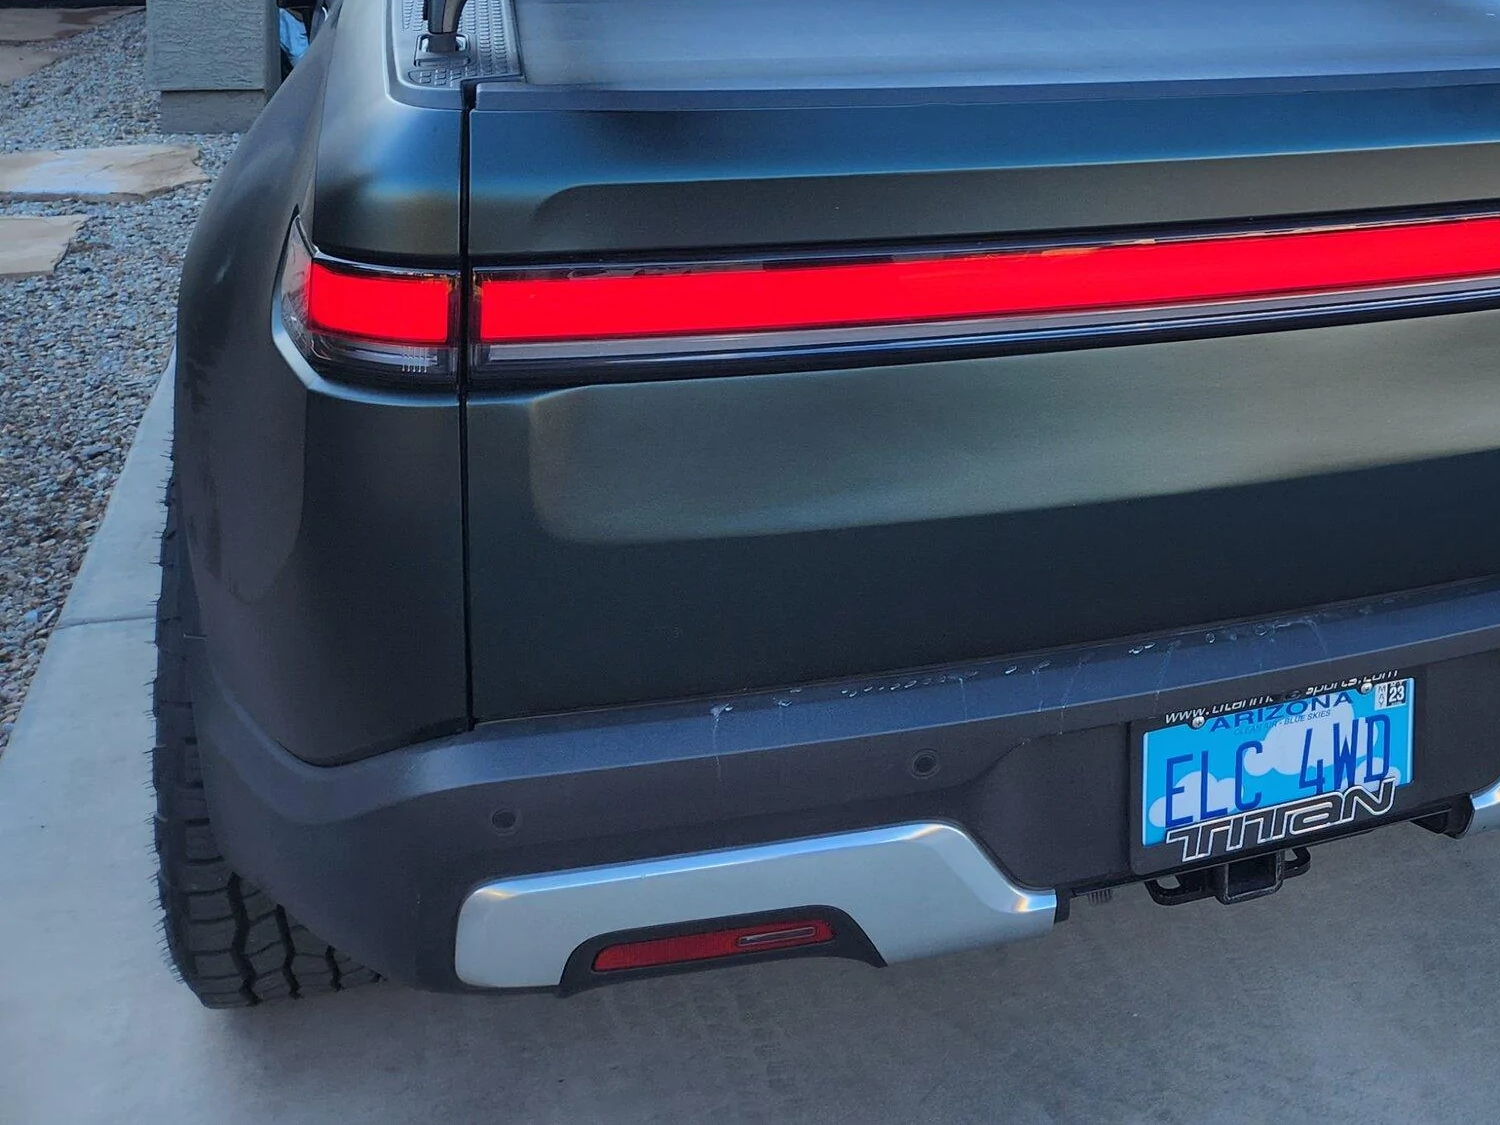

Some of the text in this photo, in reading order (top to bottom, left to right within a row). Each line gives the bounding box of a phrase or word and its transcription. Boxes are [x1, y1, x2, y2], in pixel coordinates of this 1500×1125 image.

[1389, 685, 1405, 703] 23
[1210, 691, 1354, 732] ARIZONA
[1283, 715, 1306, 726] BLUE
[1307, 709, 1332, 722] SKIES
[1164, 713, 1391, 829] ELC 4WD
